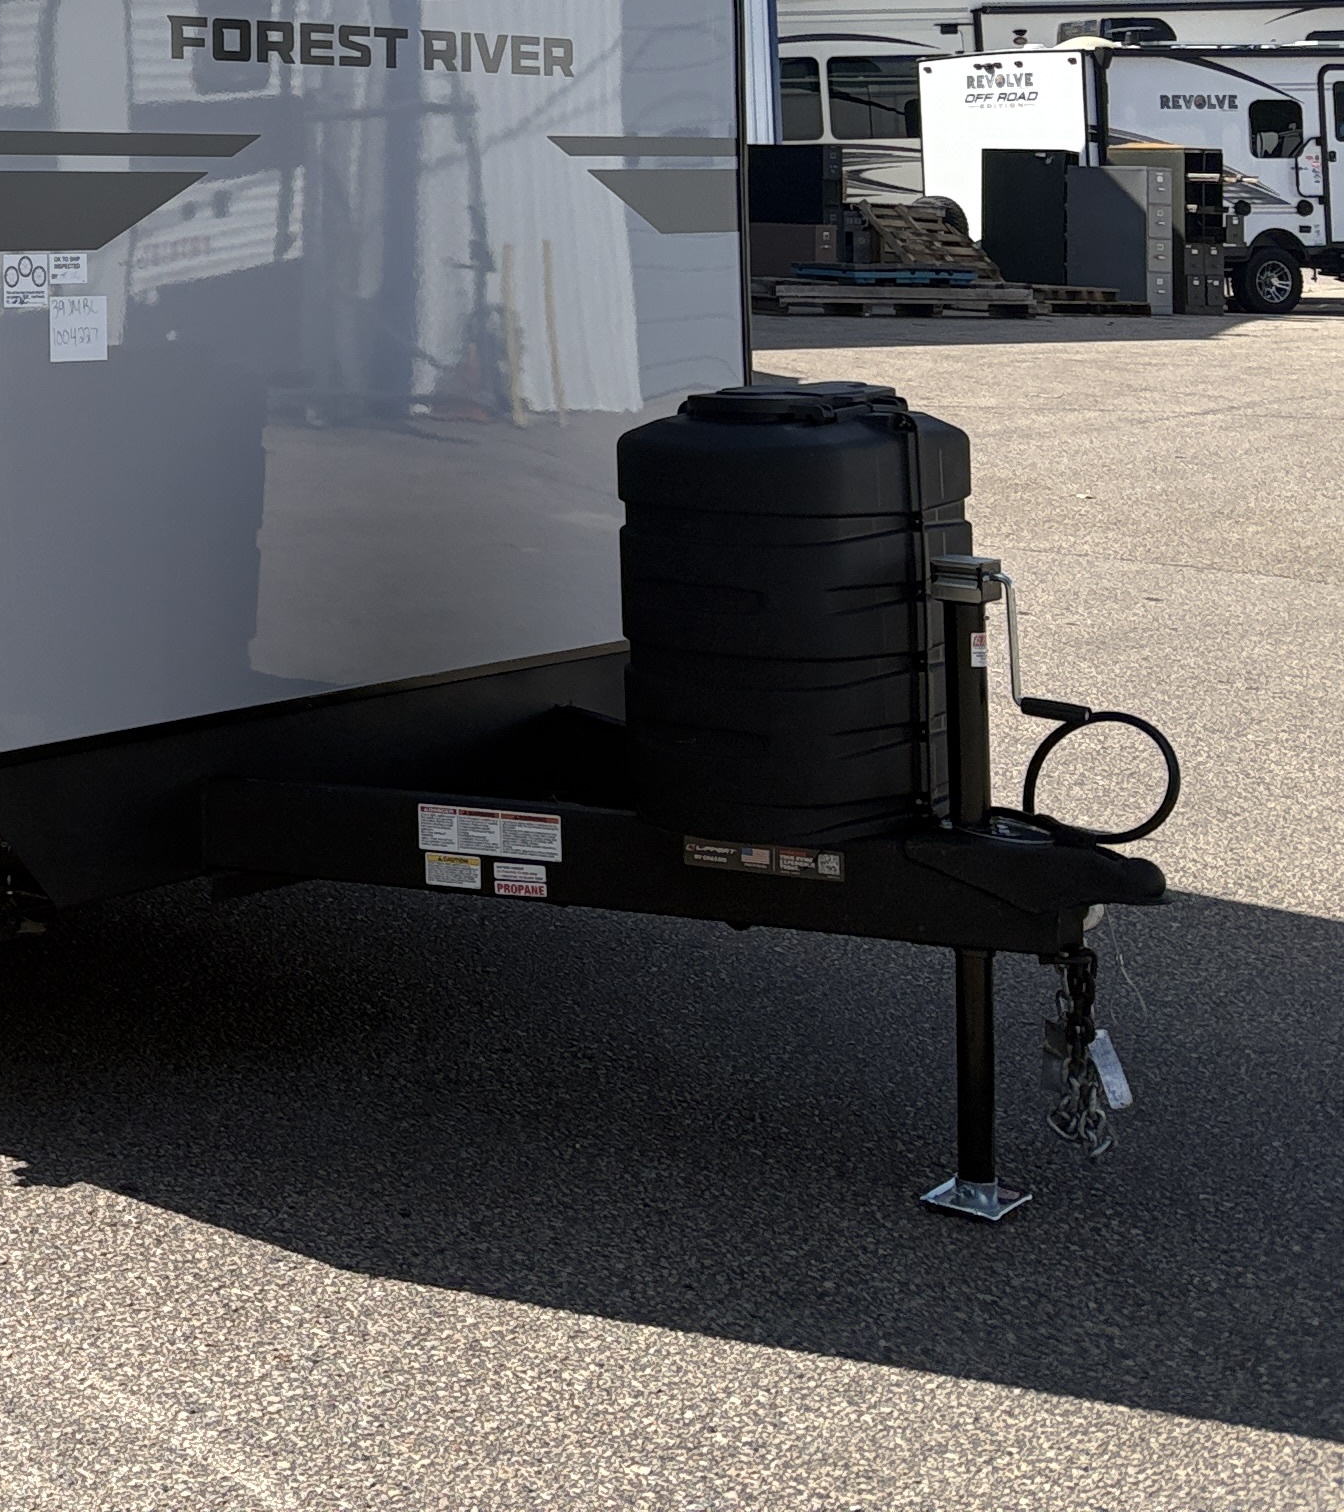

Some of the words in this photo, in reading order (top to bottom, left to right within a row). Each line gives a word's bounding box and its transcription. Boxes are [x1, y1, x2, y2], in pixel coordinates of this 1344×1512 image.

[166, 14, 409, 69] FOREST
[420, 29, 575, 78] RIVER
[966, 72, 1034, 90] REVOLVE
[964, 93, 994, 104] OFF
[997, 91, 1039, 103] ROAD
[1159, 94, 1238, 110] REVOLVE
[496, 883, 545, 896] PROPANE
